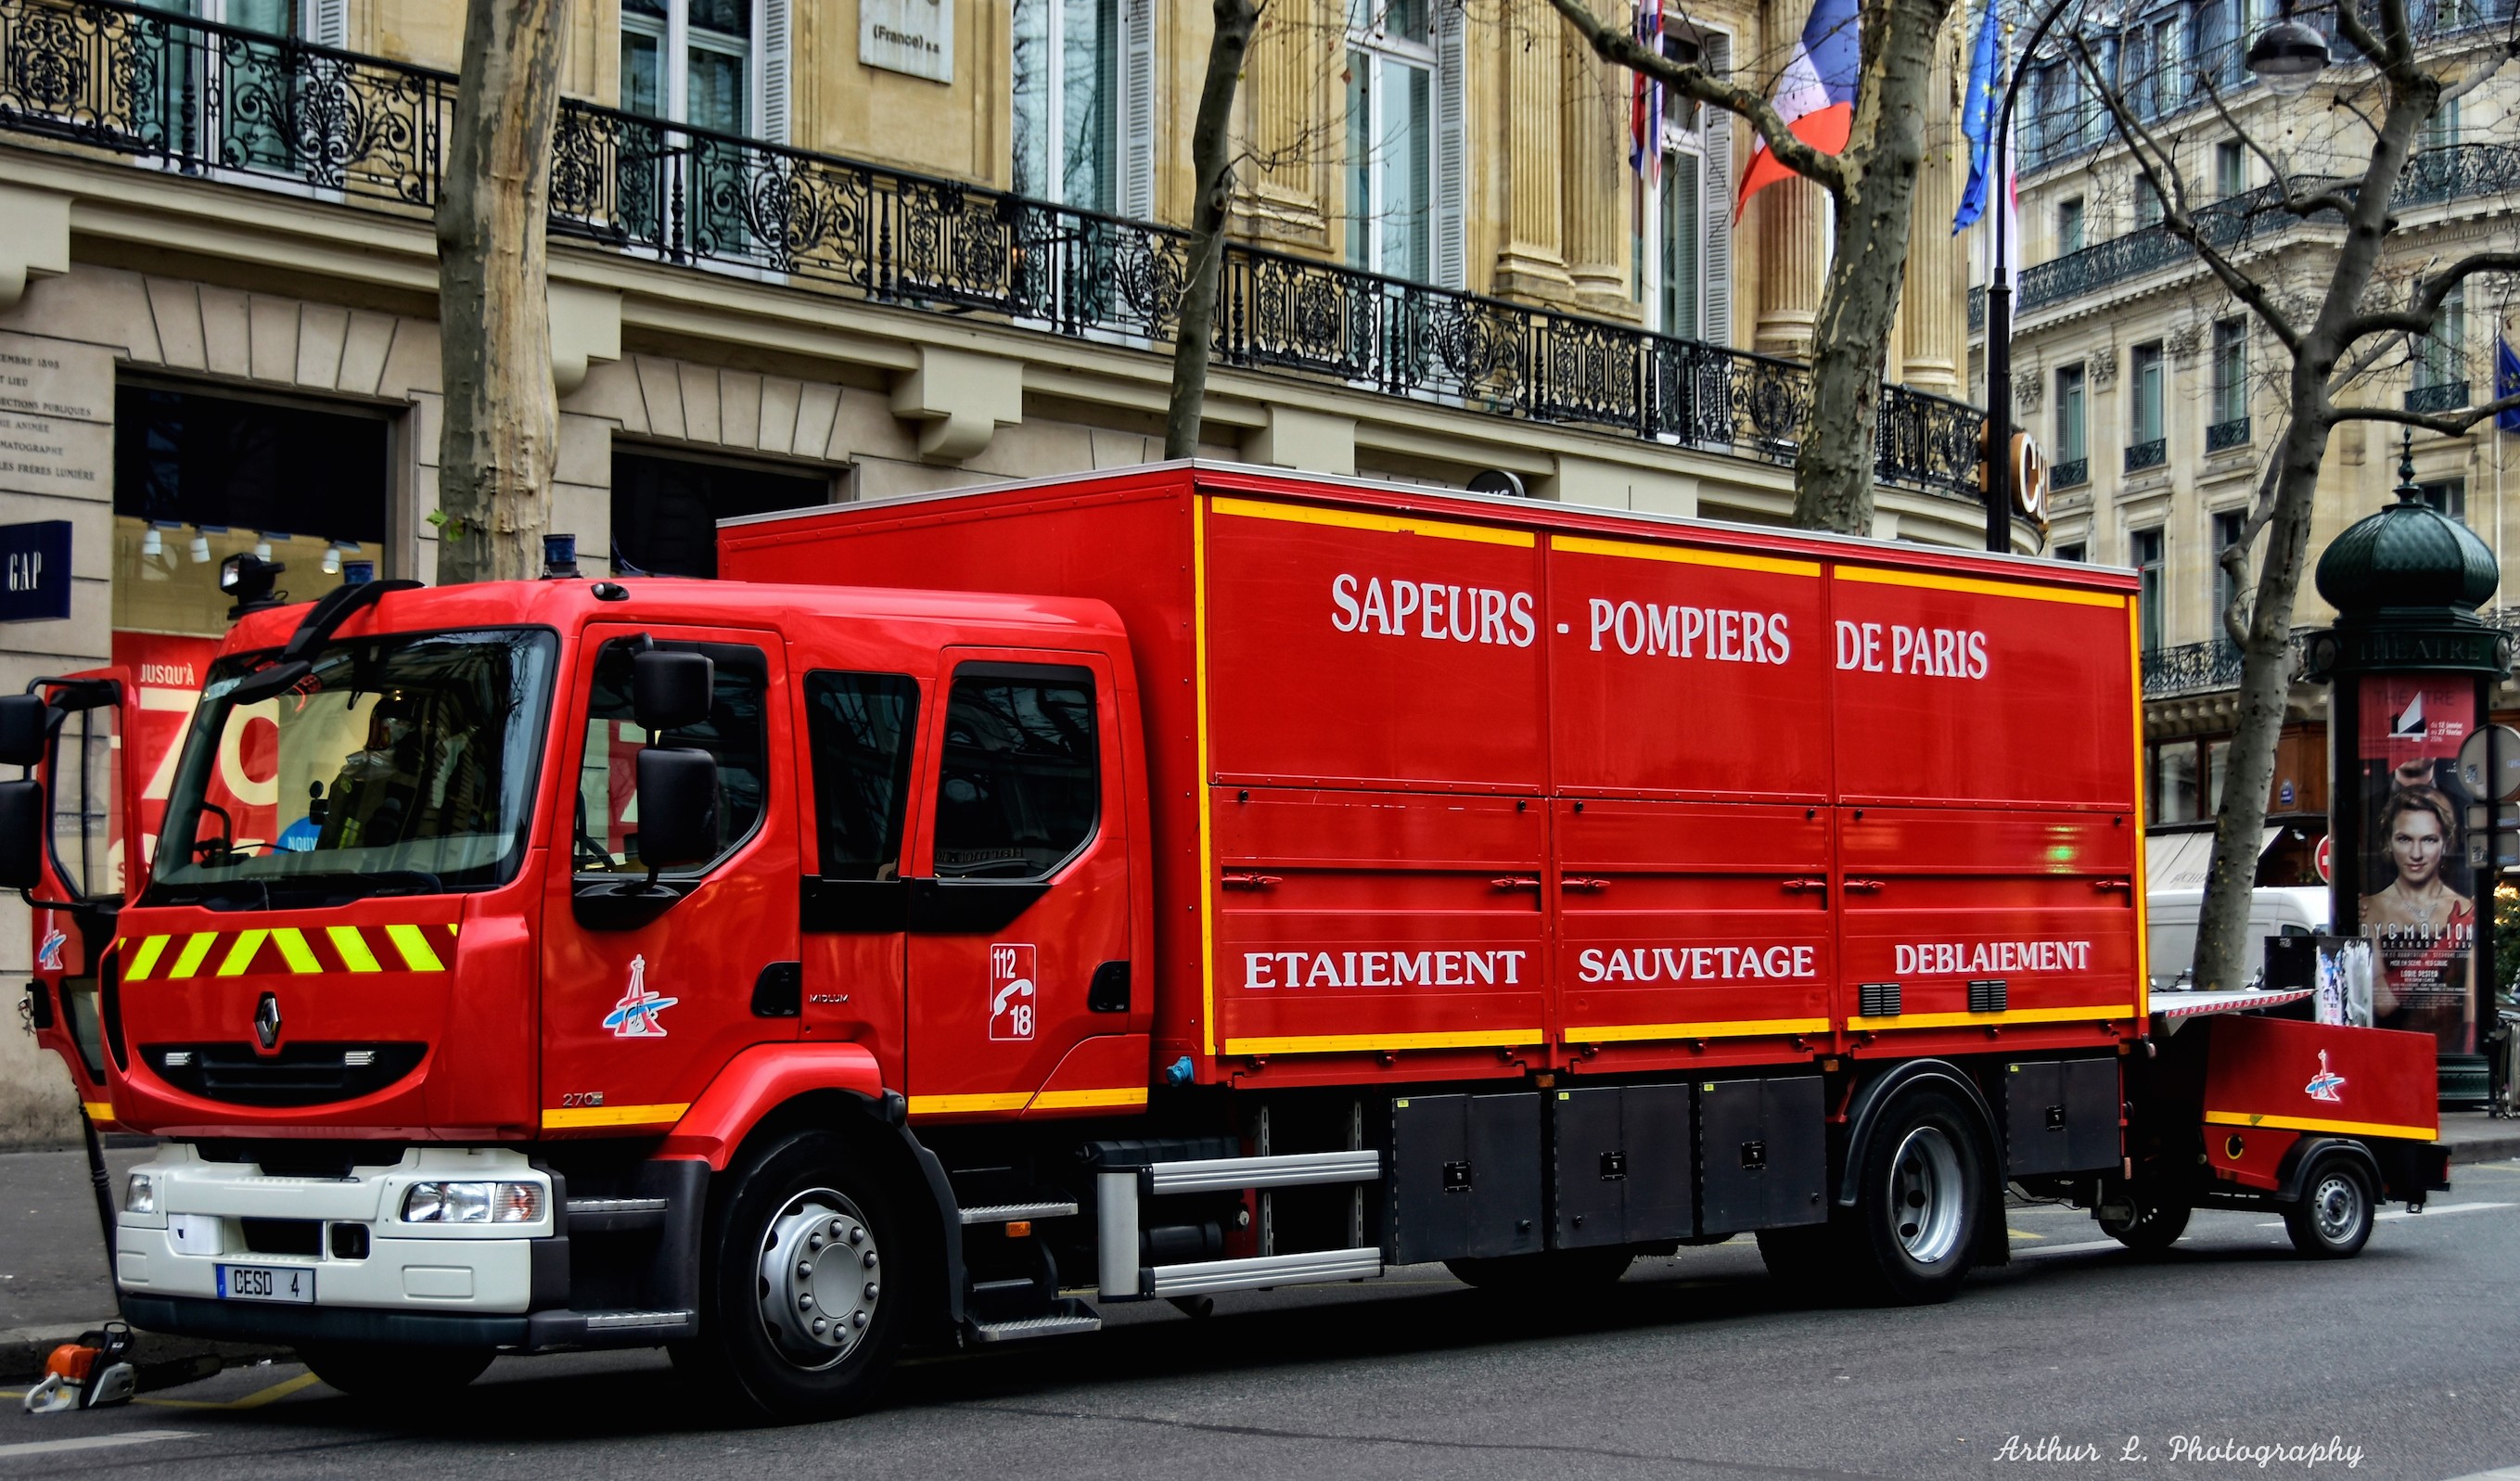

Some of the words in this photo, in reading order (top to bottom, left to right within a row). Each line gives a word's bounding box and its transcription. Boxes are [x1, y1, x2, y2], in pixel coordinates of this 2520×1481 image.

[873, 24, 924, 49] (France)
[9, 551, 42, 592] GAP
[1331, 573, 1536, 648] SAPEURS
[1589, 598, 1790, 666] POMPIERS
[1835, 620, 1884, 674] DE
[1891, 624, 1988, 680] PARIS
[140, 662, 196, 685] JUSQU'À
[993, 948, 1017, 979] 112
[1244, 950, 1527, 989] ETAIEMENT
[1578, 945, 1815, 983] SAUVETAGE
[1895, 939, 2091, 976] DEBLAIEMENT
[809, 993, 850, 1003] MIDLUM
[1009, 1004, 1031, 1036] 18
[234, 1270, 273, 1296] CESD
[290, 1272, 300, 1297] 4
